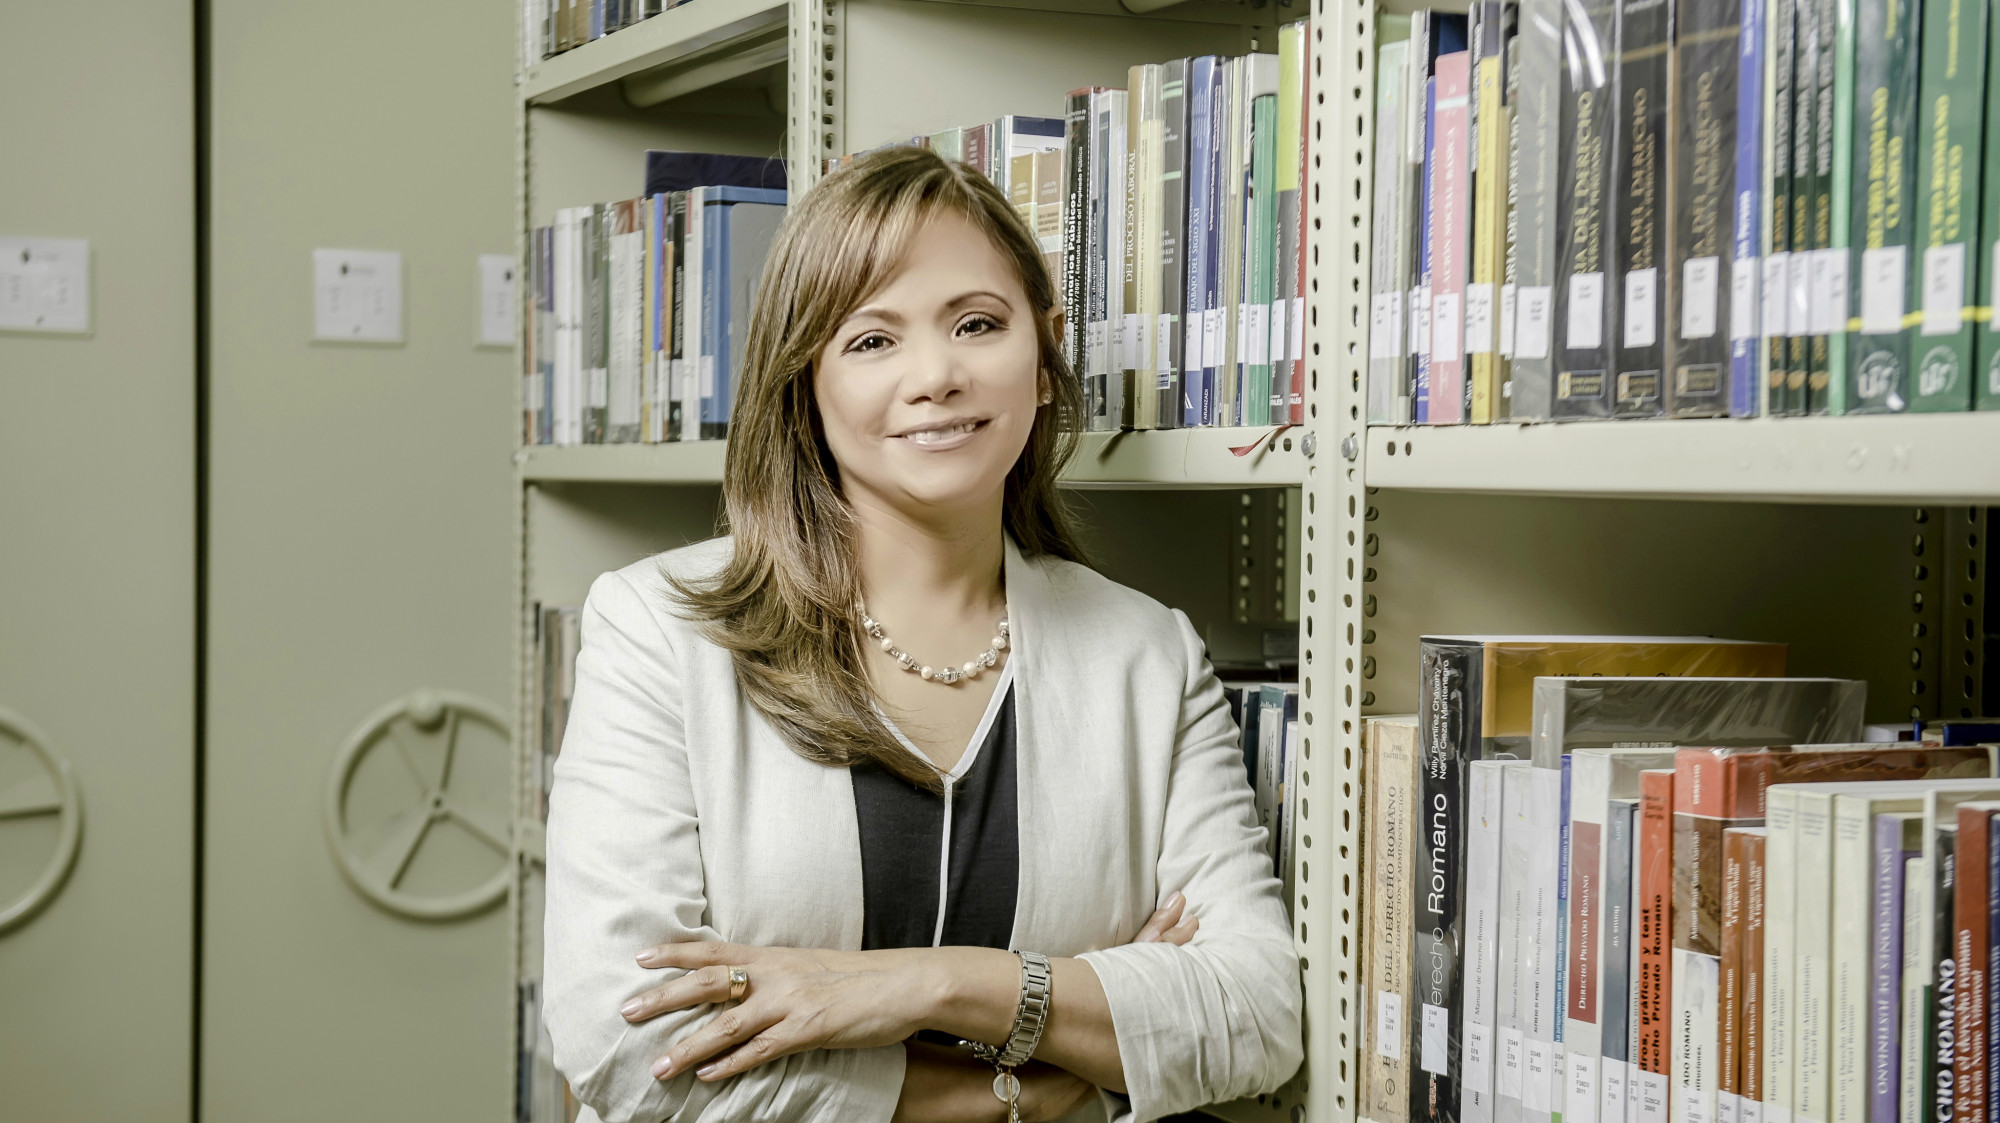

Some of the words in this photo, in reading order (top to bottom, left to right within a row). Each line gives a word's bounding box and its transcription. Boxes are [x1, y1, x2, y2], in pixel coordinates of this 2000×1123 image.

[1573, 90, 1594, 199] DERECHO
[1629, 87, 1648, 198] DERECHO
[1868, 86, 1890, 181] ROMANO
[1128, 149, 1136, 201] LABORAL
[1067, 192, 1077, 251] Públicos
[1126, 204, 1135, 257] PROCESO
[1192, 207, 1200, 225] XXI
[1573, 204, 1590, 245] DEL
[1629, 204, 1645, 245] DEL
[1191, 227, 1200, 254] SIGLO
[1125, 259, 1133, 283] DEL
[1190, 257, 1198, 273] DEL
[1440, 660, 1450, 719] Montenegro
[1430, 713, 1440, 753] Ramírez
[1440, 721, 1448, 749] Cieza
[1430, 756, 1440, 779] Willy
[1692, 763, 1702, 805] DERECHO
[1386, 786, 1396, 858] ROMANO
[1427, 793, 1448, 915] Romano
[1385, 863, 1395, 944] DERECHO
[1536, 888, 1544, 917] Romano
[1580, 874, 1590, 917] ROMANO
[1879, 847, 1893, 969] INSTITUCIONES
[1535, 918, 1543, 945] Privado
[1579, 919, 1589, 961] PRIVADO
[1641, 907, 1650, 939] test
[1653, 893, 1663, 956] Romano
[1384, 950, 1393, 983] DEL
[1429, 927, 1445, 1006] erecho
[1534, 946, 1542, 975] Derecho
[1642, 947, 1651, 955] y
[1475, 975, 1481, 985] de
[1578, 963, 1588, 1010] DERECHO
[1640, 962, 1652, 1025] gráficos
[1652, 964, 1662, 1022] Privado
[1726, 968, 1735, 998] Romano
[1749, 972, 1758, 1003] Romano
[1877, 975, 1890, 995] DE
[1725, 999, 1734, 1030] Derecho
[1748, 1003, 1757, 1034] Derecho
[1937, 958, 1957, 1065] ROMANO
[1640, 1033, 1651, 1071] dros,
[1651, 1029, 1660, 1072] recho
[1683, 1010, 1691, 1060] ROMANO
[1724, 1031, 1732, 1043] del
[1748, 1035, 1756, 1048] del
[1876, 1000, 1890, 1095] JUSTINIANO
[1723, 1044, 1732, 1087] aprendizaje
[1748, 1048, 1757, 1092] aprendizaje
